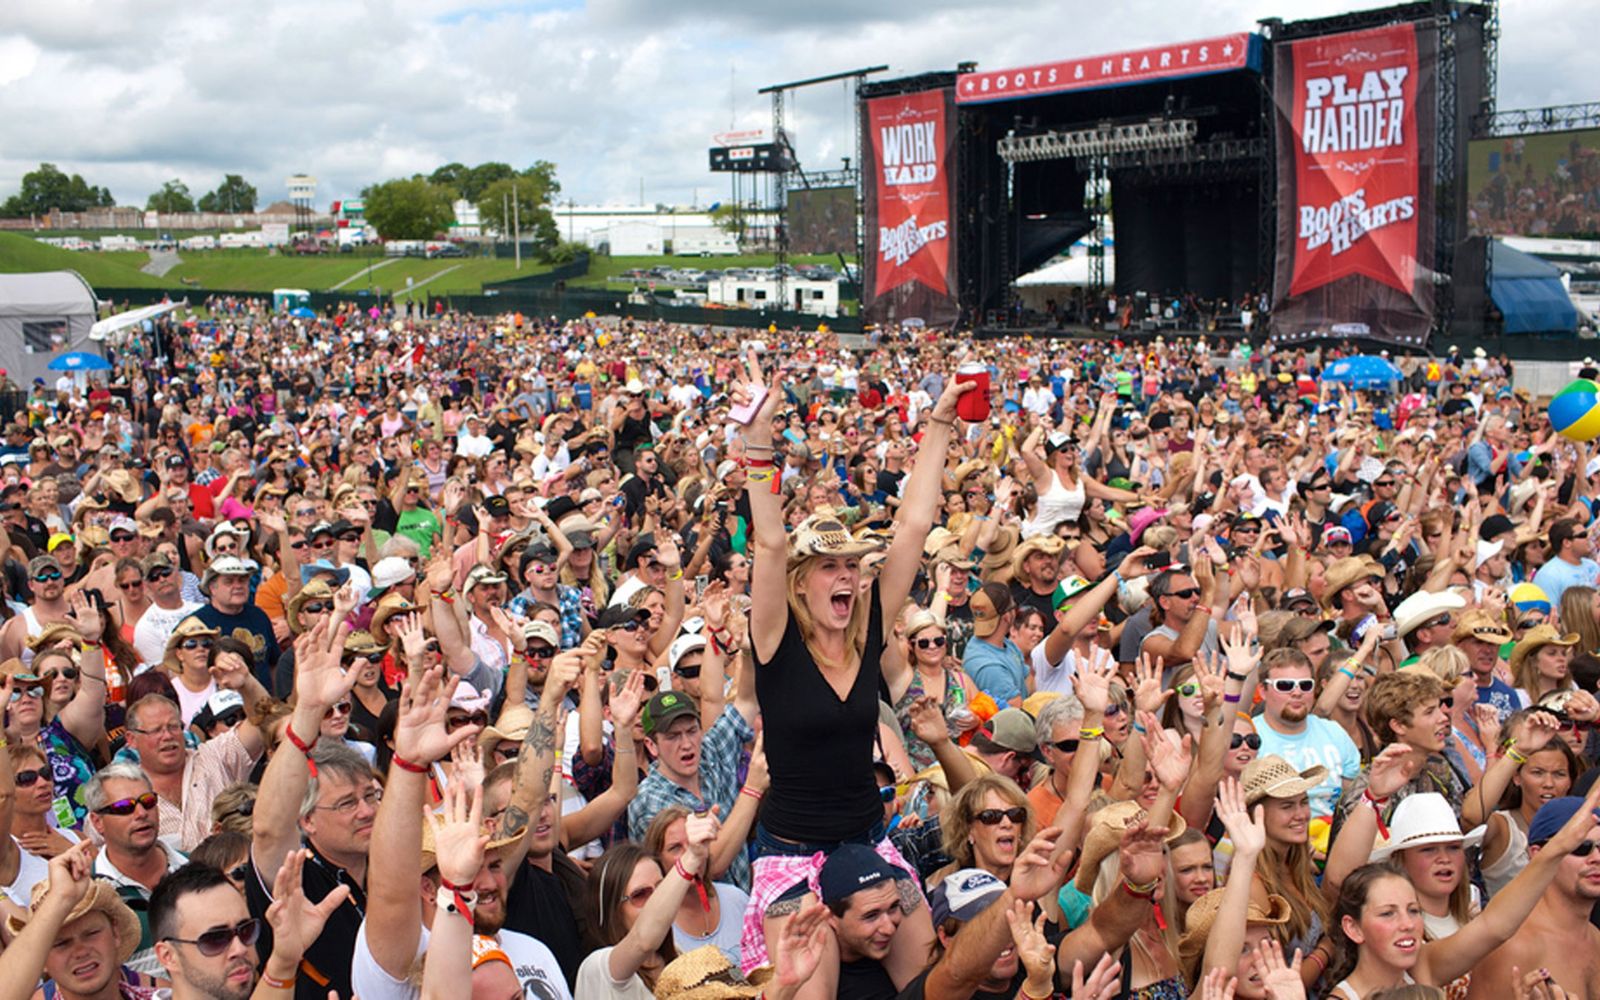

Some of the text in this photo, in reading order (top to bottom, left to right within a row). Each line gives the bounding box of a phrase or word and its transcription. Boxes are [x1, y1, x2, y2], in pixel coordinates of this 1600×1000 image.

[980, 46, 1209, 92] BOOTS & HEARTS
[1305, 66, 1408, 108] PLAY
[881, 121, 937, 166] WORK
[1302, 98, 1404, 153] HARDER
[883, 163, 937, 186] HARD
[967, 875, 992, 888] Ford
